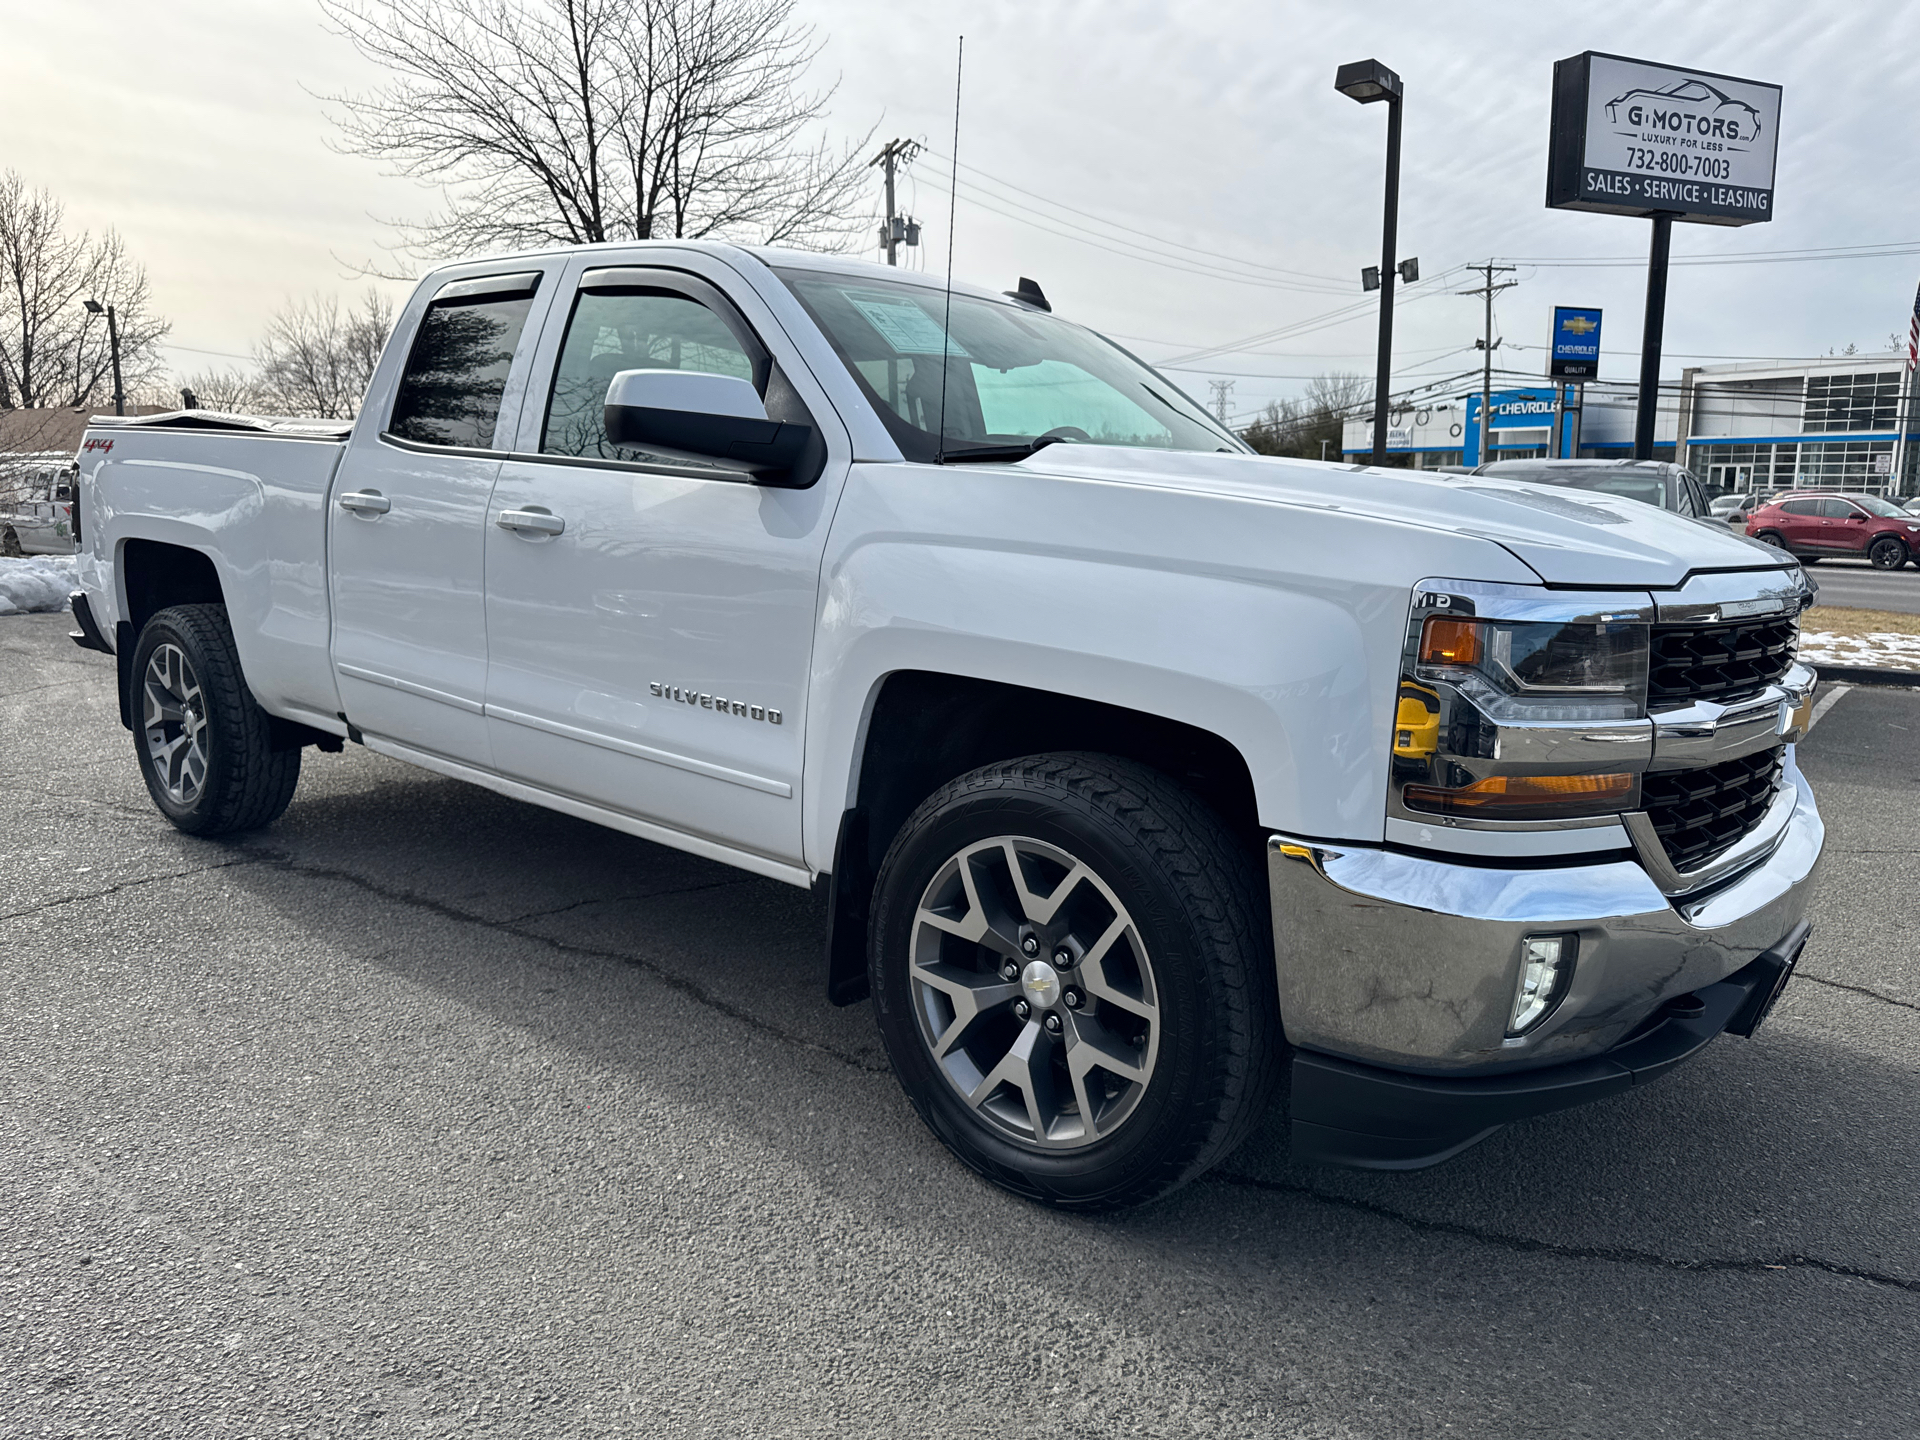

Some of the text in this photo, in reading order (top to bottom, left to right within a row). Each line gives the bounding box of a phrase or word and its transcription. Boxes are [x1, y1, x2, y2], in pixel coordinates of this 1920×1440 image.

[1642, 132, 1723, 152] LUXURY FOR LESS
[1627, 147, 1730, 180] 732-800-7003
[1587, 172, 1768, 210] SALES SERVICE LEASING
[1557, 344, 1597, 355] CHEVROLET
[1564, 366, 1587, 374] QUALITY
[1499, 401, 1556, 415] CHEVROLE
[650, 681, 782, 725] SILVERADO
[875, 896, 890, 1014] KUMHO
